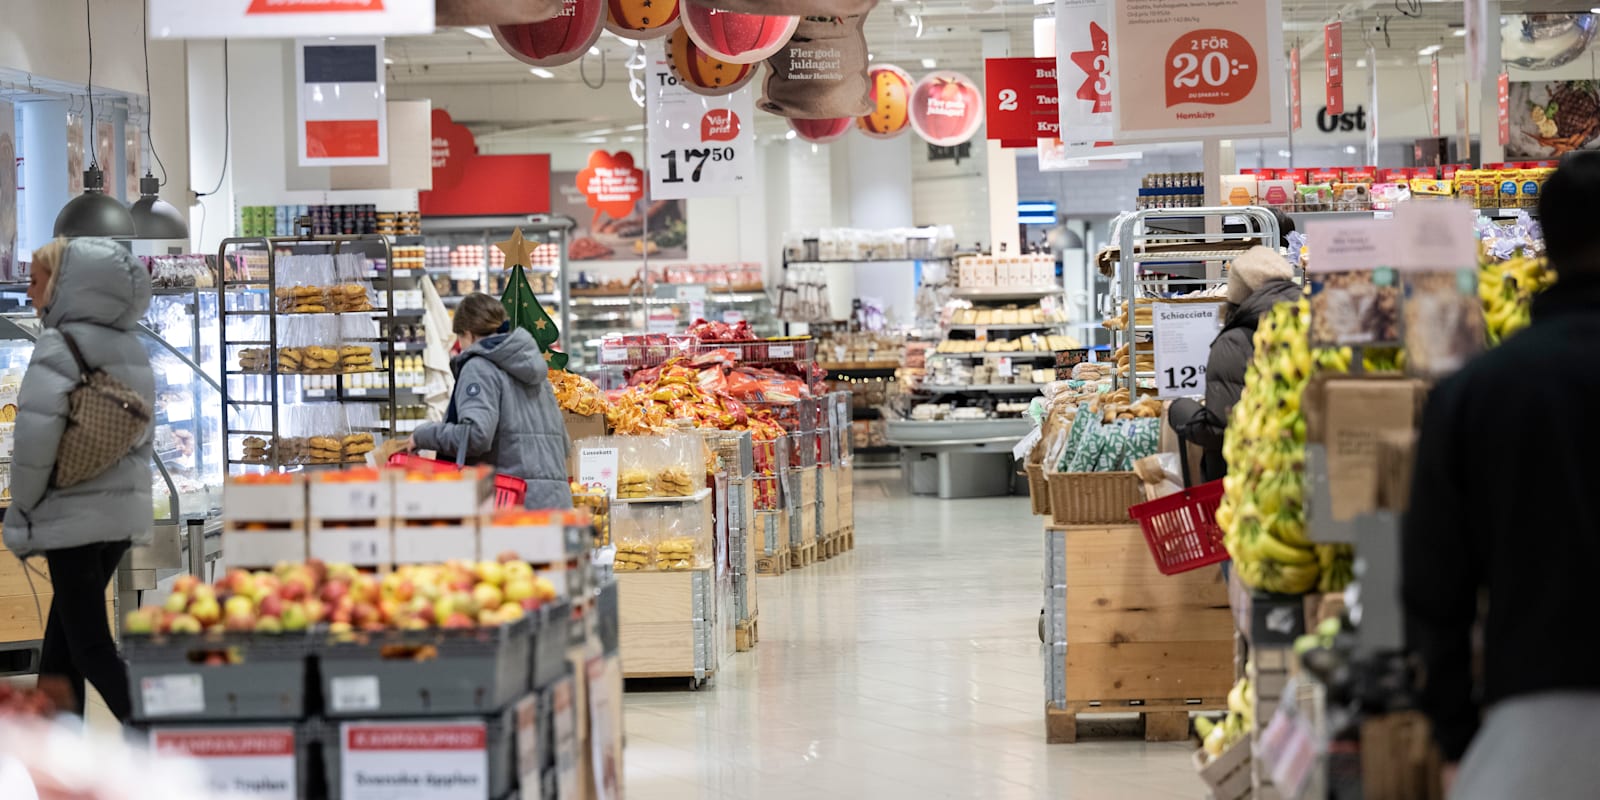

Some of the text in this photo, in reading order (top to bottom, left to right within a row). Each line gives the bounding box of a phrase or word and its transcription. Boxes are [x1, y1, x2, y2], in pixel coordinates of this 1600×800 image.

[1101, 41, 1107, 50] 2
[1191, 37, 1229, 50] 2 FÖR
[790, 47, 841, 60] Fler goda
[789, 59, 840, 71] juldagar!
[1173, 51, 1248, 88] 20:-
[656, 72, 683, 86] To
[998, 89, 1018, 111] 2
[1317, 104, 1366, 132] Ost
[661, 147, 734, 183] 17 50
[1160, 310, 1213, 320] Schiacciata
[1163, 365, 1198, 389] 12
[355, 772, 419, 787] Svenska
